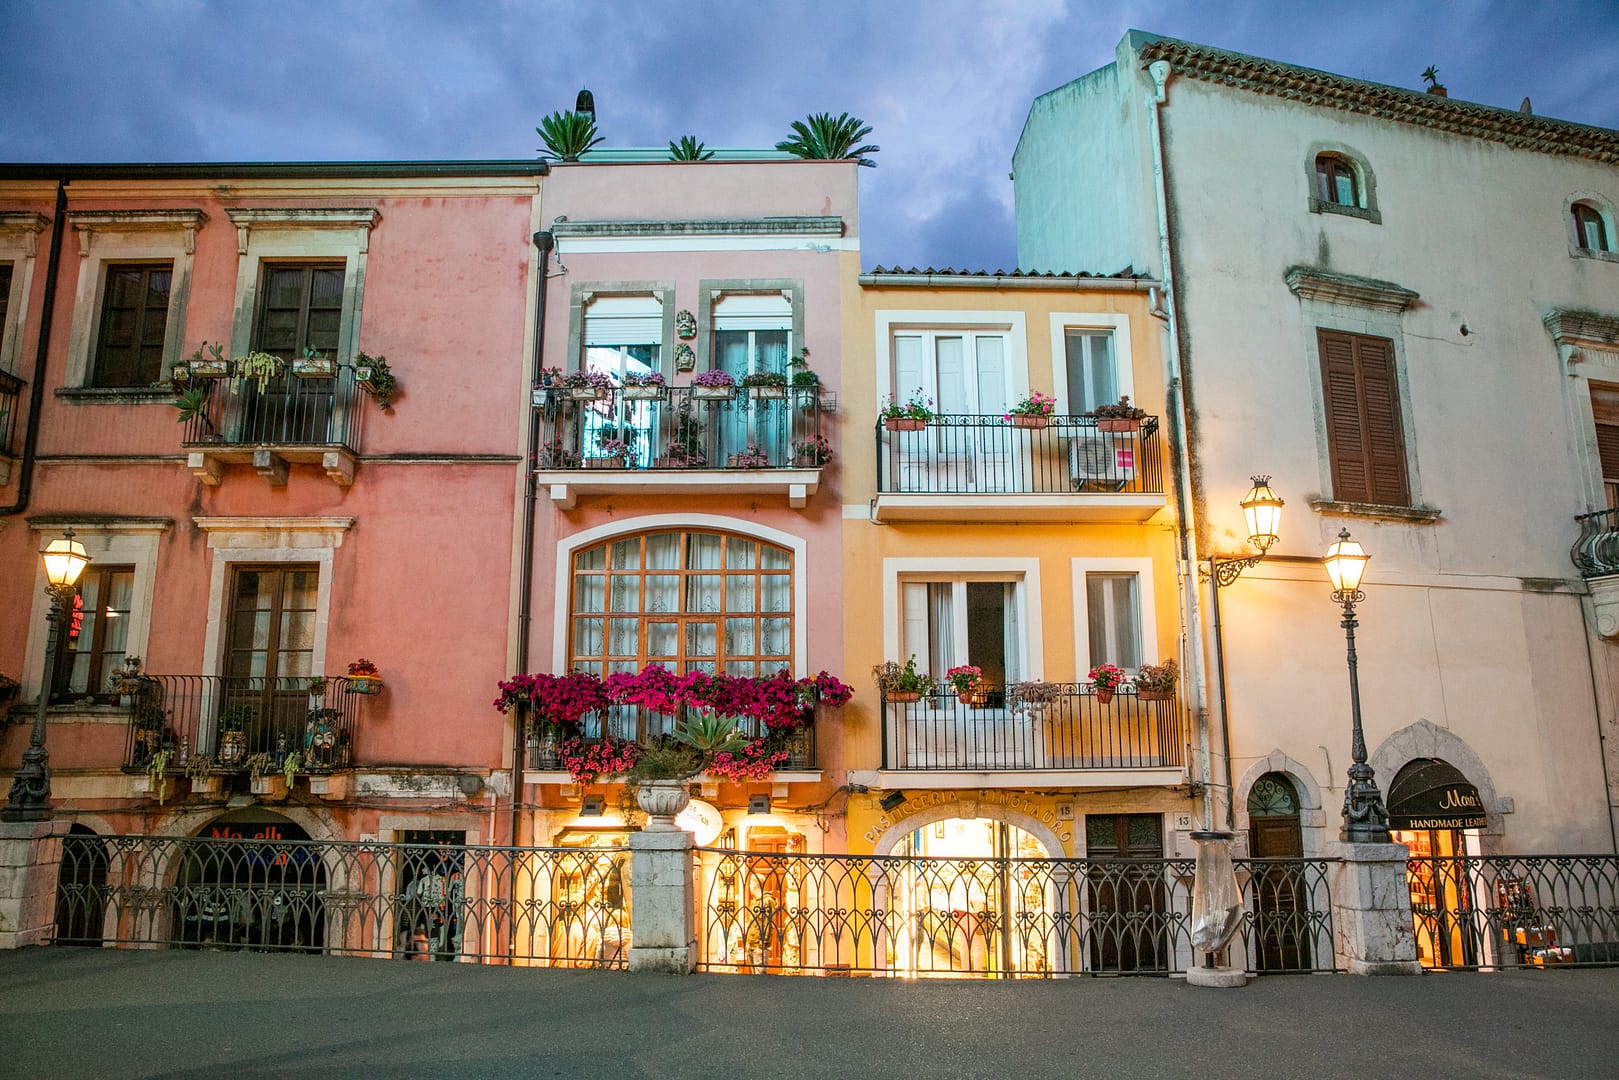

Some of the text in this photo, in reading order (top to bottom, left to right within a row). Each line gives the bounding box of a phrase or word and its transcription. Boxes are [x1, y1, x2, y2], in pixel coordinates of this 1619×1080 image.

[1060, 806, 1070, 815] 15
[864, 790, 1072, 844] PASTICCERIA MINOTAURO
[1178, 816, 1189, 825] 13
[1410, 819, 1463, 829] HANDMADE
